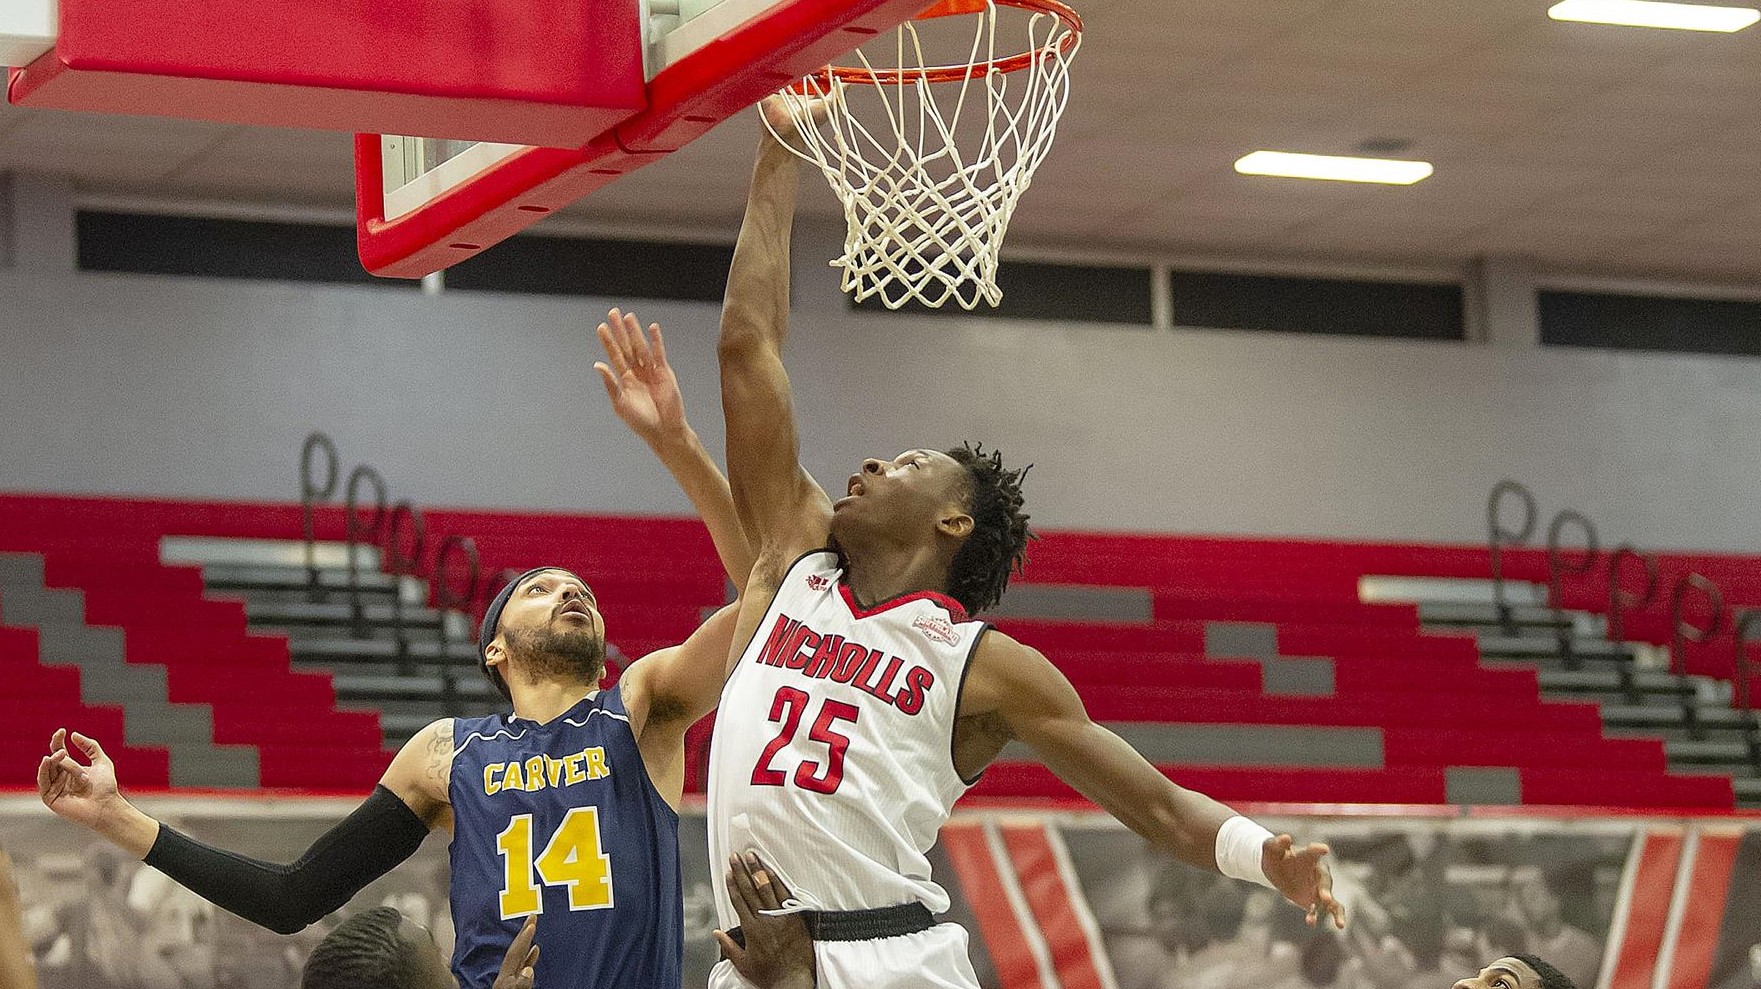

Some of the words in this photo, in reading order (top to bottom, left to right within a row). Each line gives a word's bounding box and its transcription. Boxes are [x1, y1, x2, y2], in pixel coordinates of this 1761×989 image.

[756, 613, 934, 716] NICHOLLS
[483, 746, 611, 796] CARVER
[750, 685, 860, 795] 25
[496, 805, 615, 921] 14
